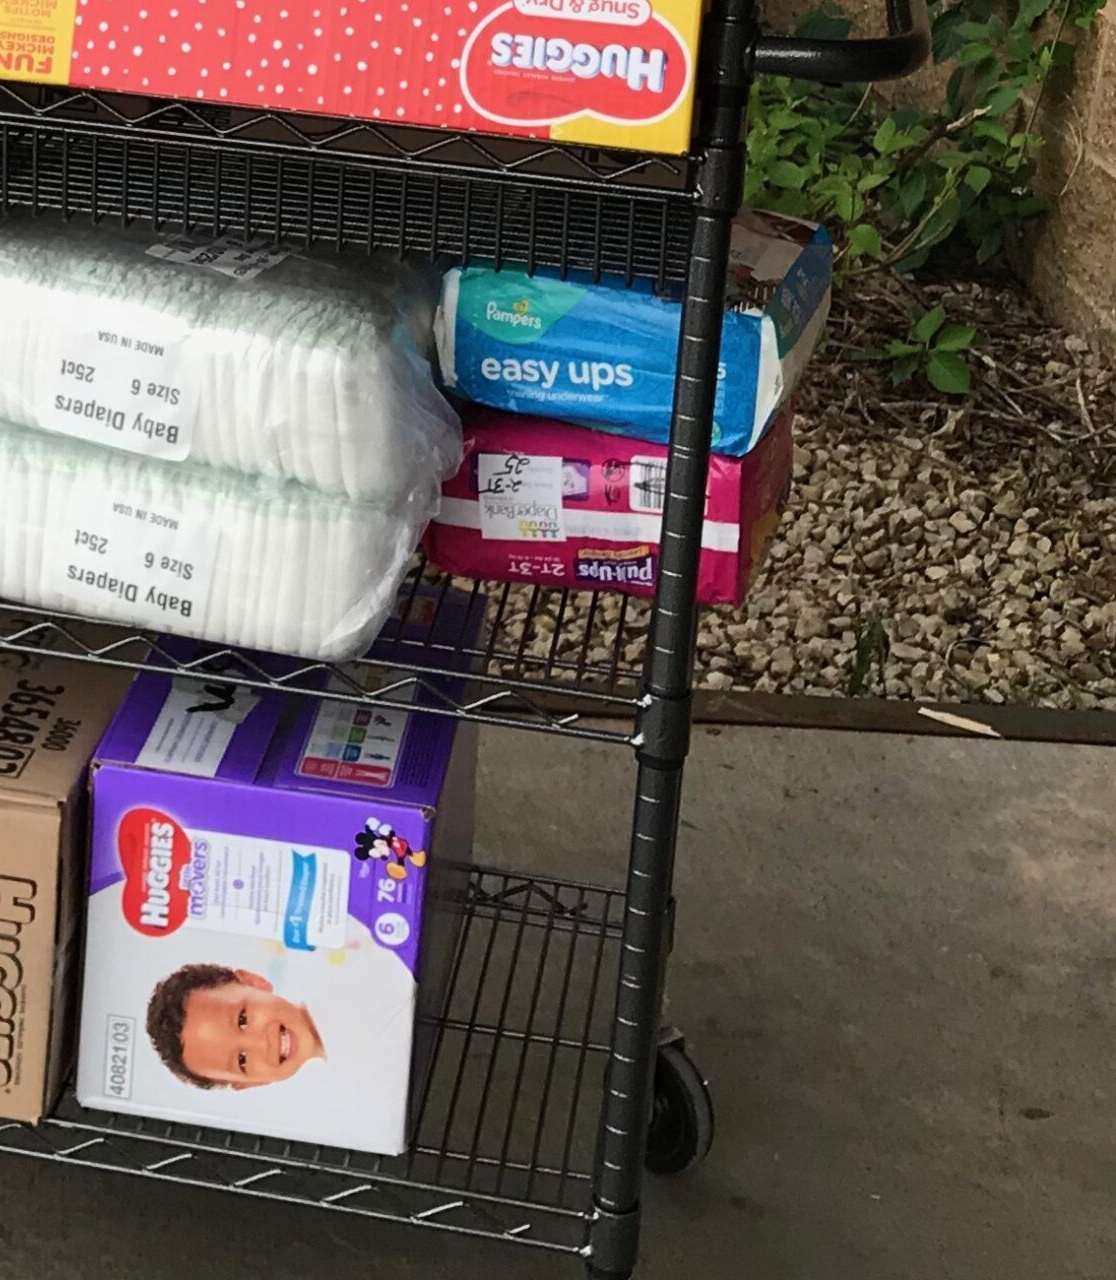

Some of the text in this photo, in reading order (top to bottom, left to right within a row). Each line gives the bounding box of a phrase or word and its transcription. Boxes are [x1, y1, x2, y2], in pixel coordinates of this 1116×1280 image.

[3, 5, 51, 18] MOTIFS
[489, 31, 666, 93] HUGGIES
[486, 301, 542, 330] Pampers
[98, 330, 165, 357] MADE IN USA
[61, 359, 180, 405] Size 6 25ct
[481, 357, 634, 391] easy ups
[55, 394, 180, 444] Baby Diapers
[113, 502, 179, 530] MADE IN USA
[483, 501, 557, 520] Diaper Bank
[74, 529, 194, 580] Size 6 25ct
[508, 562, 566, 576] 2T-3T
[67, 564, 192, 617] Baby Diapers
[42, 718, 82, 751] 36000
[140, 822, 174, 927] HUGGIES
[190, 841, 209, 916] movers
[377, 878, 397, 904] 76
[378, 922, 395, 936] 6
